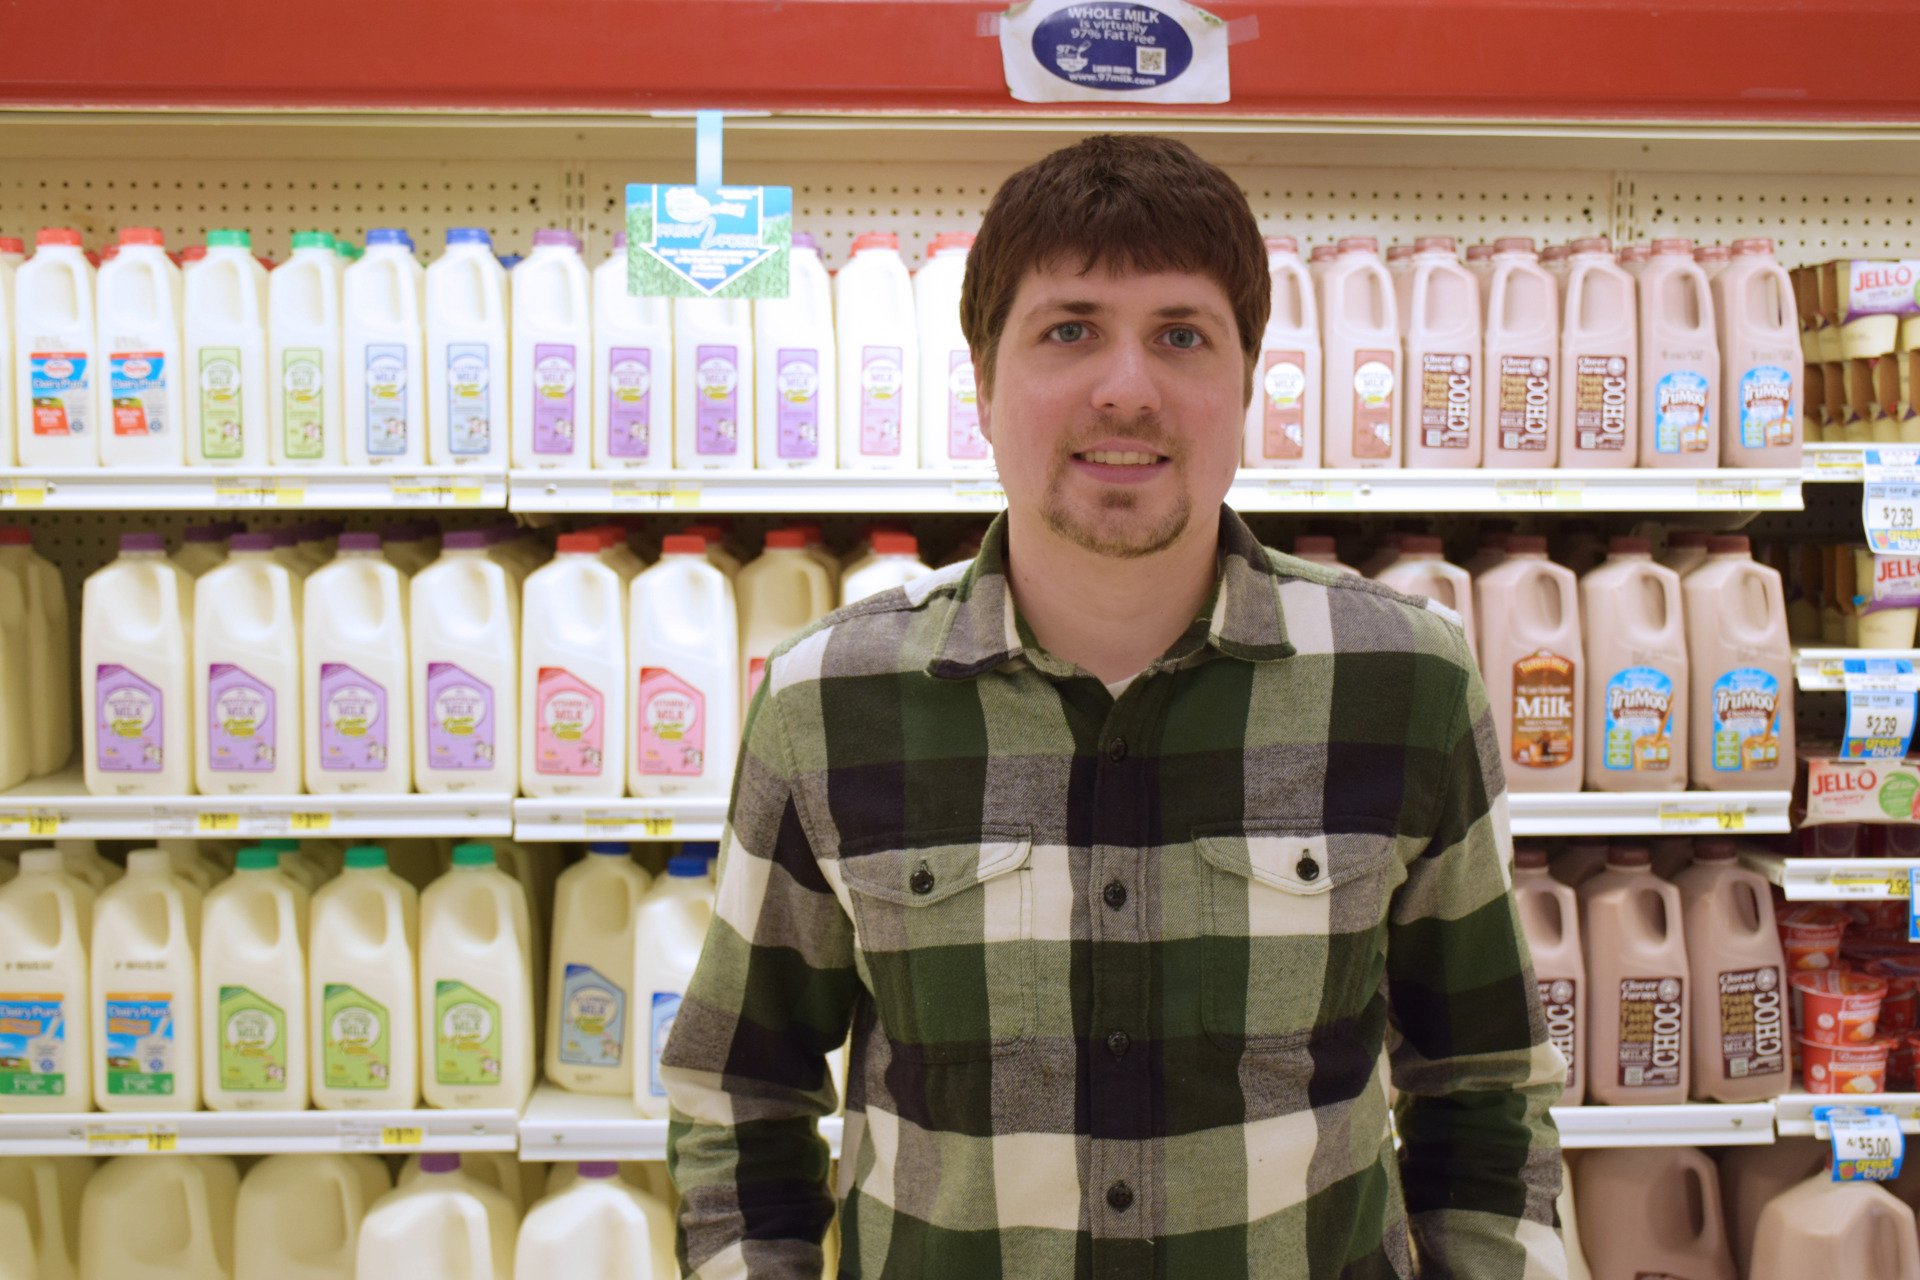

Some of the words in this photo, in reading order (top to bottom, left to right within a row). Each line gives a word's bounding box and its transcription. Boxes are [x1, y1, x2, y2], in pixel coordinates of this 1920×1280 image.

[1067, 8, 1121, 22] WHOLE
[1124, 9, 1160, 24] MILK
[1070, 28, 1102, 40] 97%
[1104, 30, 1125, 42] Fat
[1126, 32, 1156, 45] Free
[1079, 19, 1091, 28] is
[1092, 20, 1148, 36] virtually
[1068, 73, 1156, 86] www.97milk.com
[1447, 374, 1470, 432] CHOC
[1660, 388, 1706, 408] TruMoo
[1744, 382, 1790, 402] TruMoo
[1525, 376, 1548, 434] CHOC
[1602, 376, 1626, 434] CHOC
[1883, 506, 1913, 528] $2.39
[1516, 696, 1572, 718] Milk
[1611, 688, 1668, 712] TruMoo
[1717, 688, 1774, 712] TruMoo
[1866, 716, 1898, 736] $2.39
[1753, 991, 1782, 1056] CHOC
[1652, 1002, 1681, 1068] CHOC
